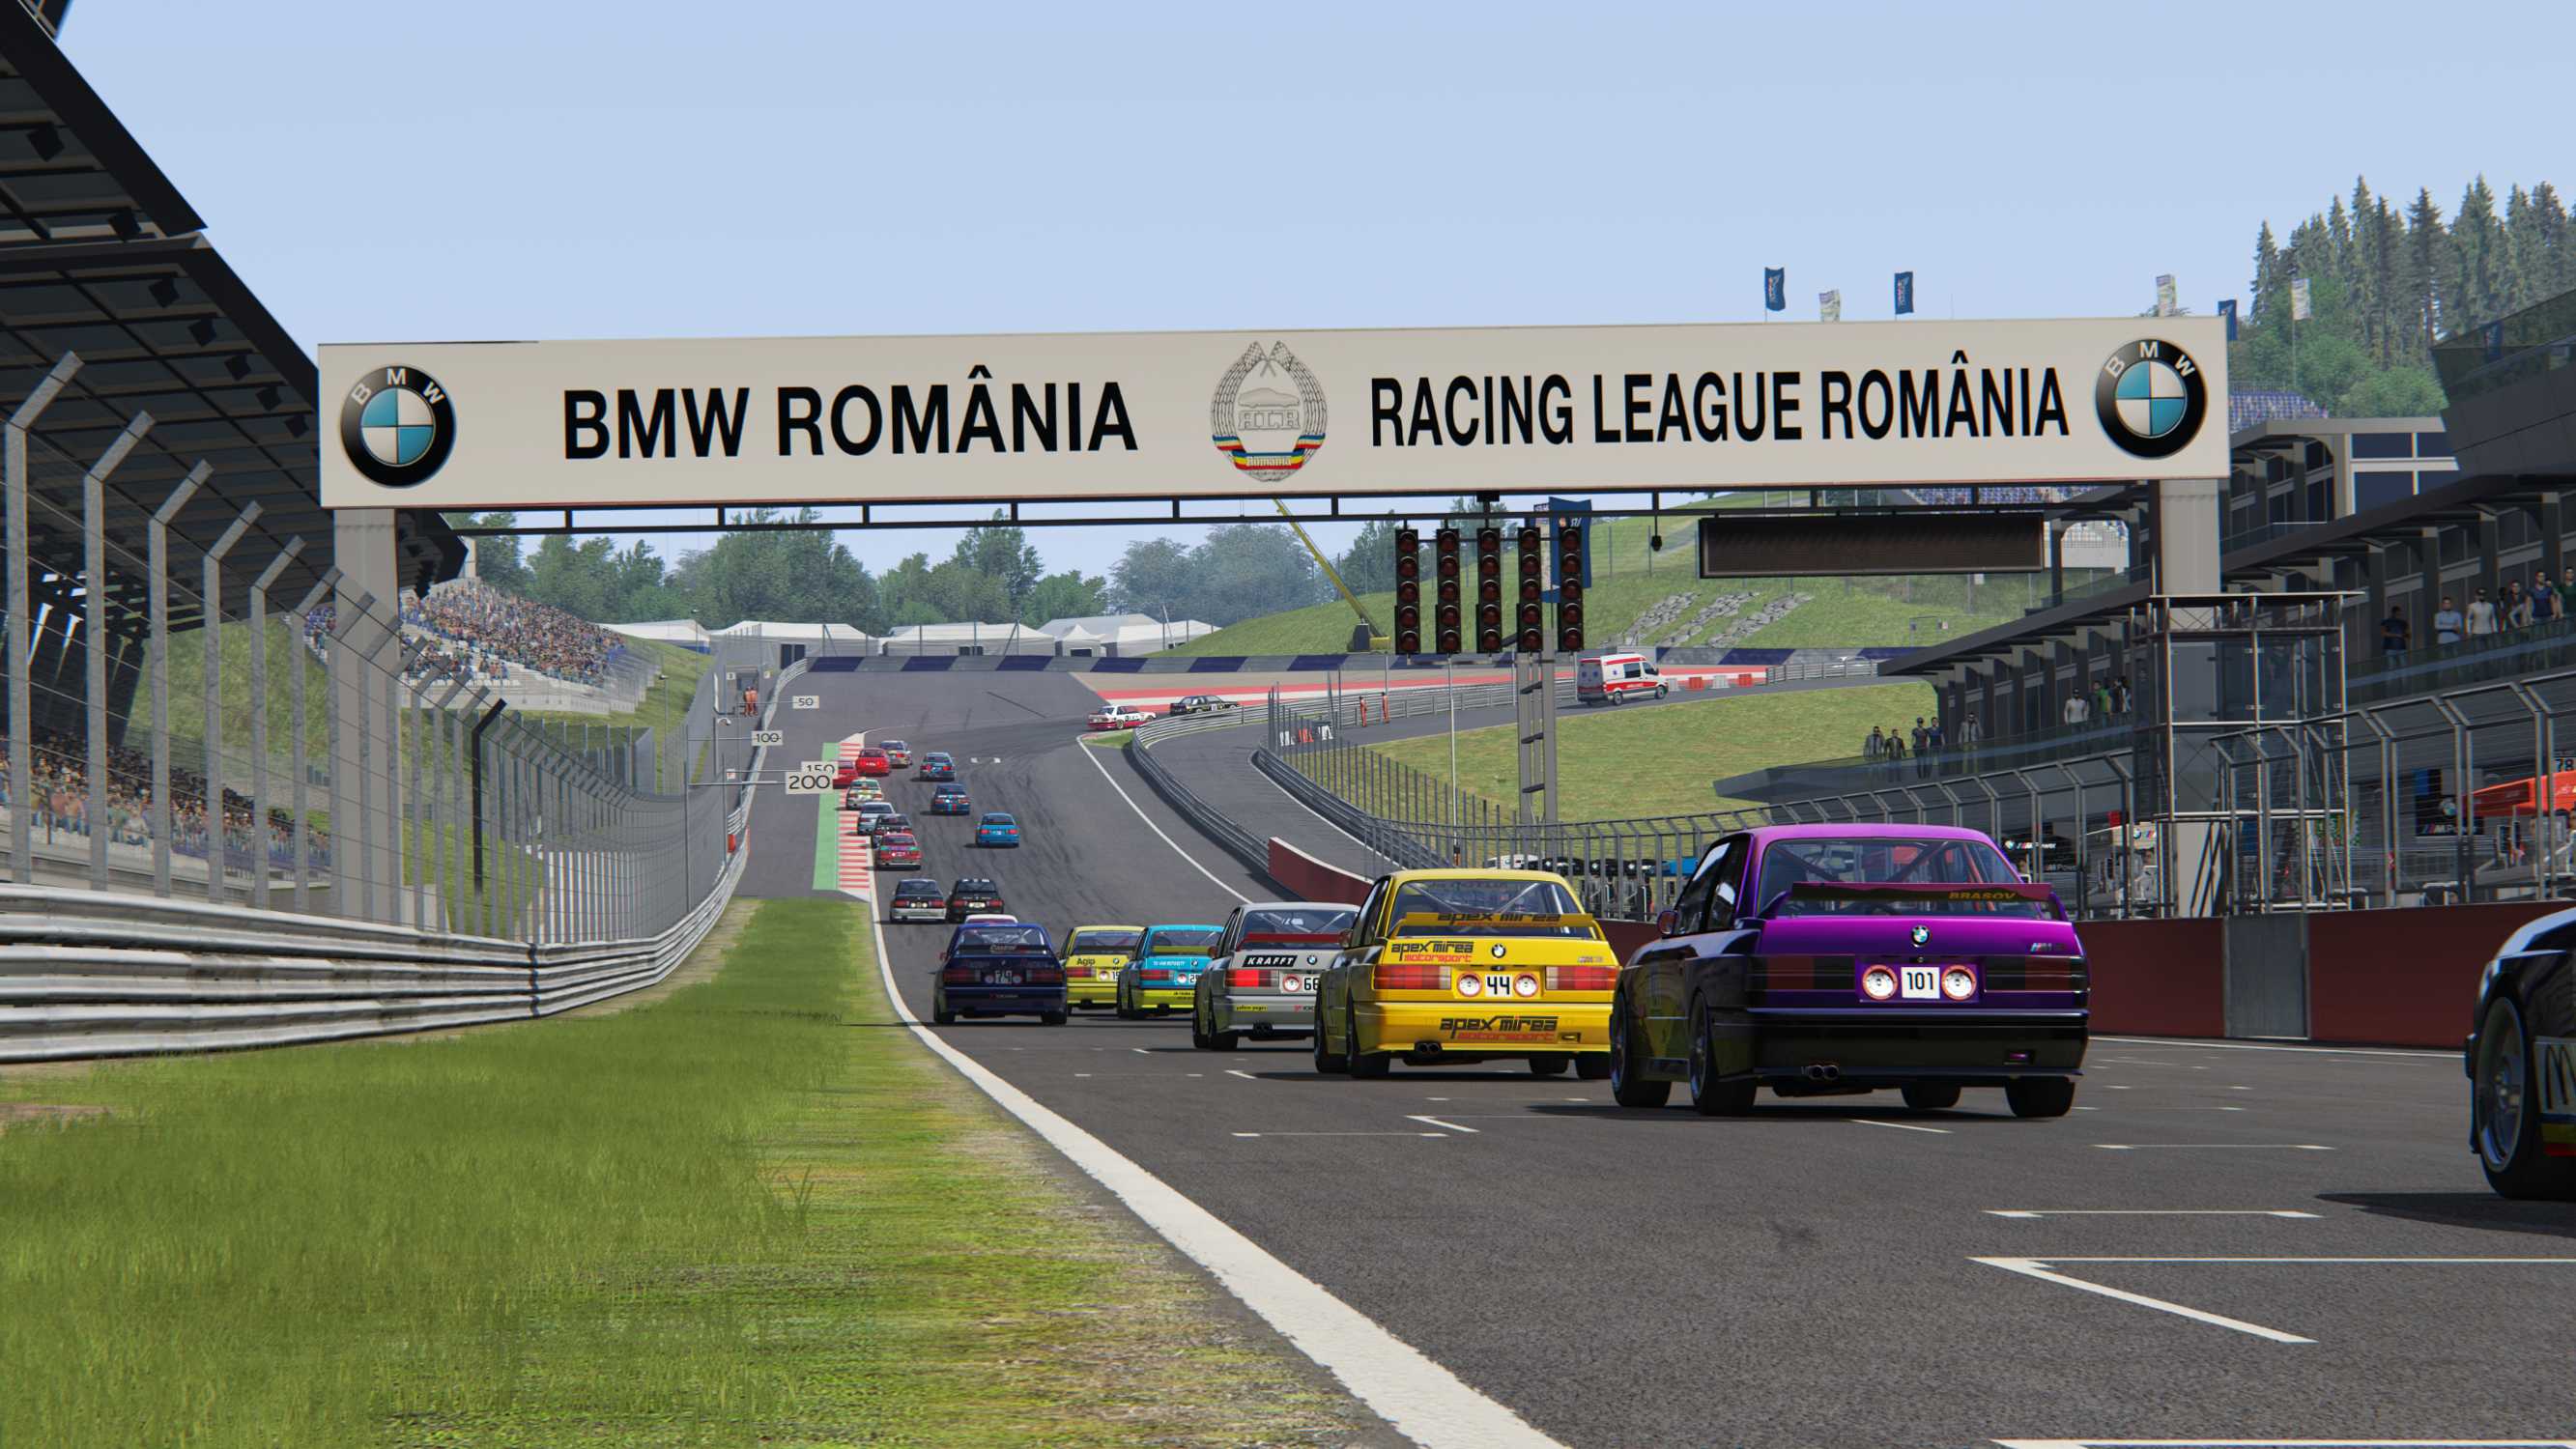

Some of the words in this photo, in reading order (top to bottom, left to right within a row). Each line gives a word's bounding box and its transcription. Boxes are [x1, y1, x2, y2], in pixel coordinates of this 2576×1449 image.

[2104, 340, 2196, 379] BMW
[351, 367, 446, 406] BMW
[1370, 375, 1574, 447] RACING
[1592, 371, 1803, 444] LEAGUE
[1821, 350, 2071, 440] ROMÂNIA
[563, 387, 750, 459] BMW
[777, 364, 1138, 456] ROMÂNIA
[798, 697, 814, 707] 50
[756, 732, 780, 743] 100
[2555, 758, 2574, 772] 78
[788, 775, 831, 789] 200
[1391, 941, 1431, 961] apex
[1076, 957, 1096, 967] Agip
[1246, 956, 1294, 965] KRAFFT
[1486, 976, 1510, 995] 44
[1906, 972, 1933, 990] 101
[1440, 1016, 1499, 1039] apex
